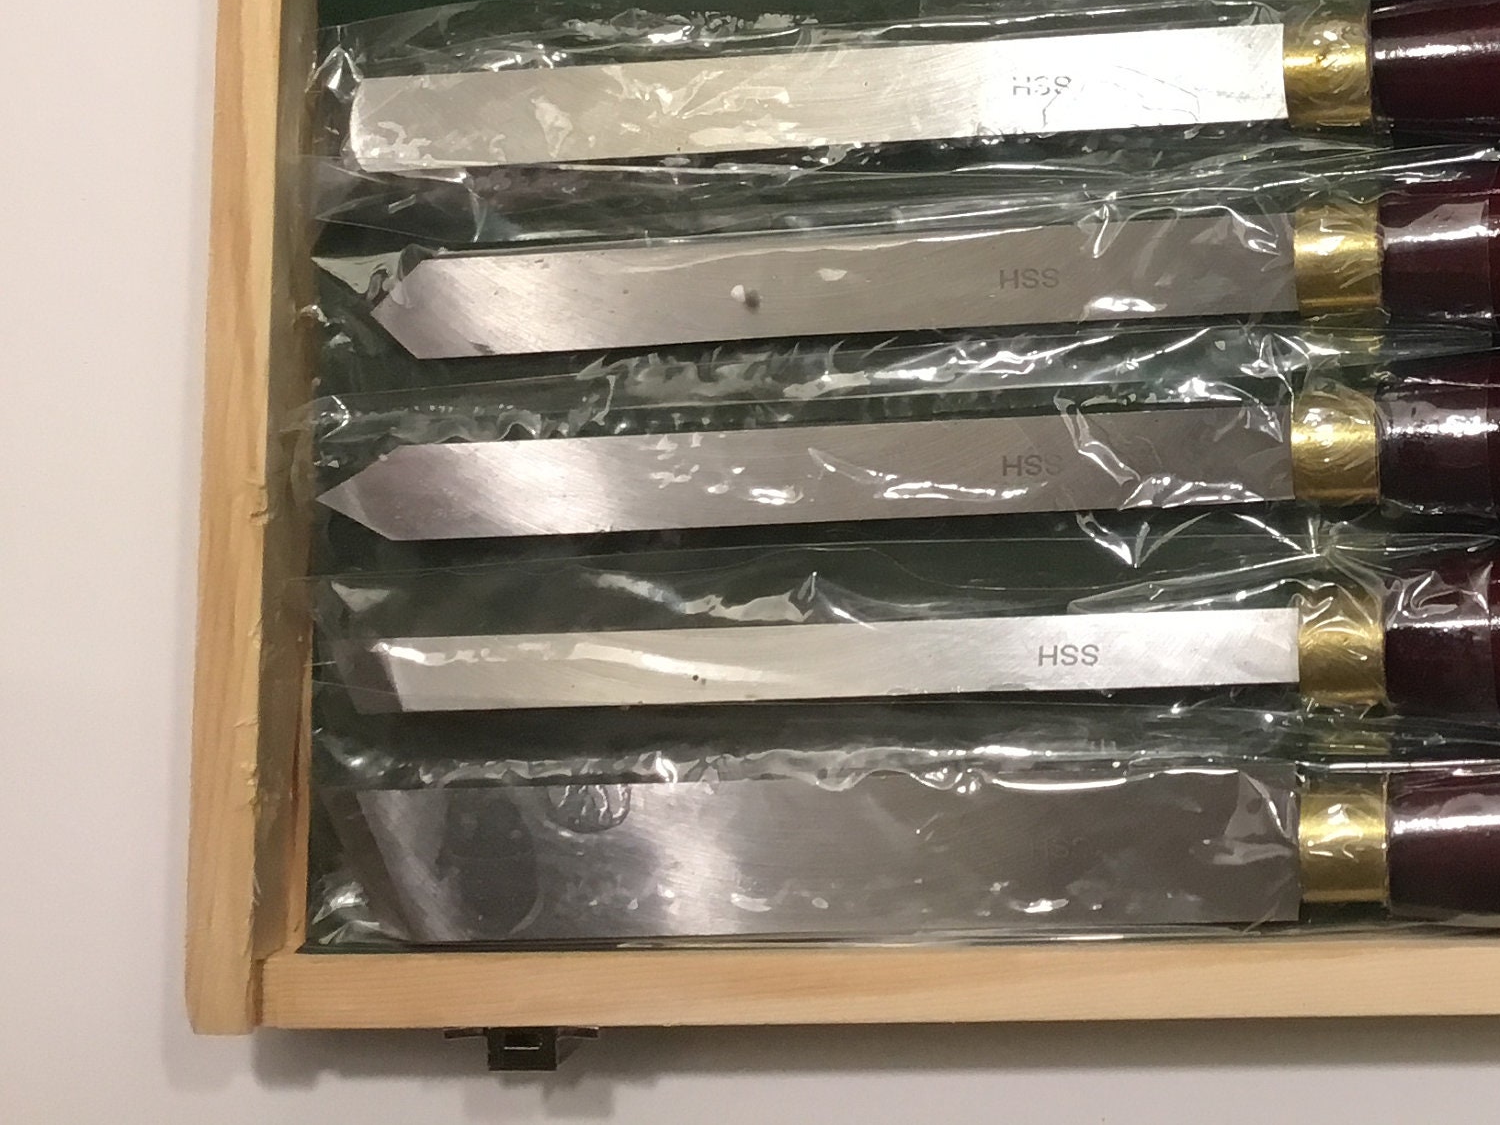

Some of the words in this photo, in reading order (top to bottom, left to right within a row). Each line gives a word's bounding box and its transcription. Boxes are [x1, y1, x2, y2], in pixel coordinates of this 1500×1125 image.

[999, 268, 1061, 290] HSS
[1002, 454, 1063, 477] HSS
[1037, 644, 1100, 667] HSS
